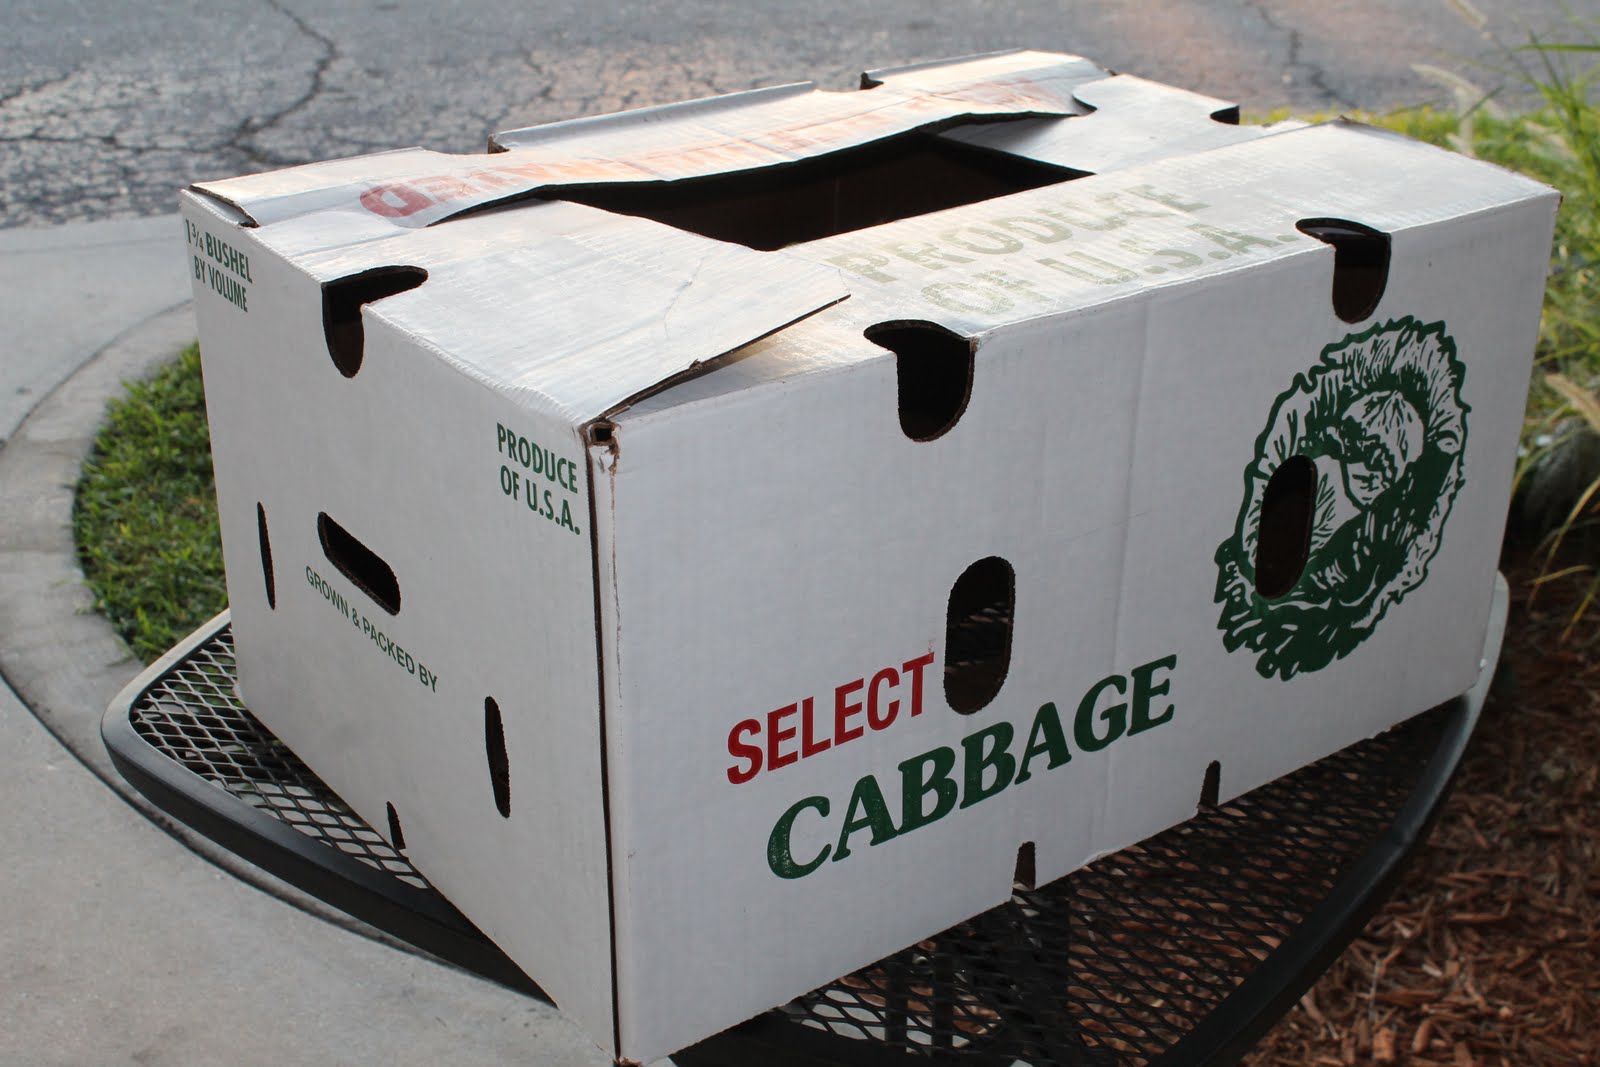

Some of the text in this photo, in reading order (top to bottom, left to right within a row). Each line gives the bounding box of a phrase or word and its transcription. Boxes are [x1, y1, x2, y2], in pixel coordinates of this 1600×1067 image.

[205, 231, 253, 284] BUSHEL
[825, 184, 1210, 284] PRODUCE
[194, 255, 248, 313] BY VOLUME
[920, 269, 1050, 316] OF
[496, 422, 578, 494] PRODUCE
[500, 464, 581, 536] OF U.S.A.
[305, 565, 438, 693] GROWN & PACKED BY
[726, 651, 935, 785] SELECT
[766, 654, 1178, 880] CABBAGE
